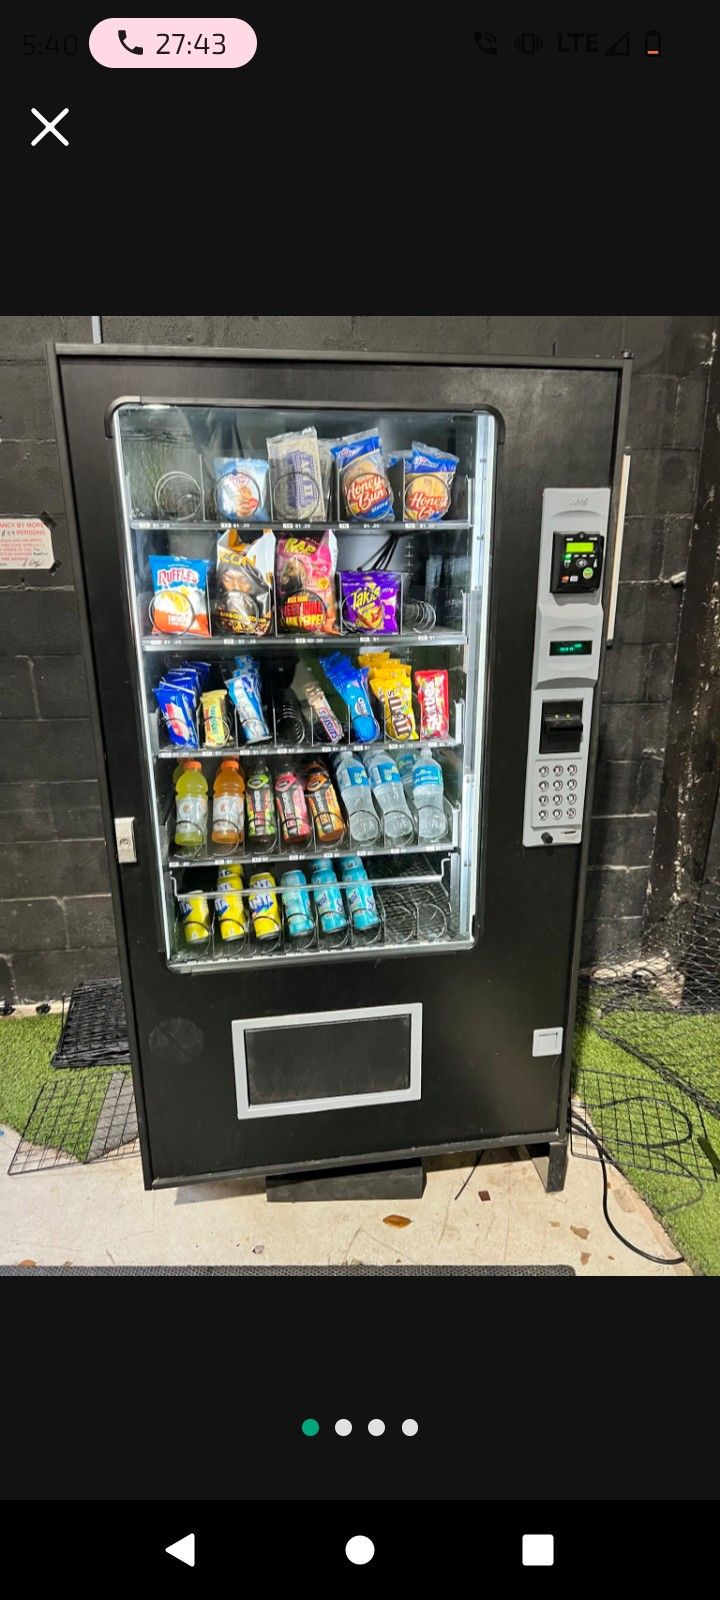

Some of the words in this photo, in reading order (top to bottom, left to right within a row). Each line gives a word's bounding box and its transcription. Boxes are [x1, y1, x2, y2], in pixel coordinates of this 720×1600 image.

[347, 475, 382, 499] Honey
[359, 488, 386, 510] Bun
[411, 492, 449, 508] Honey
[157, 567, 200, 586] RUFFLES
